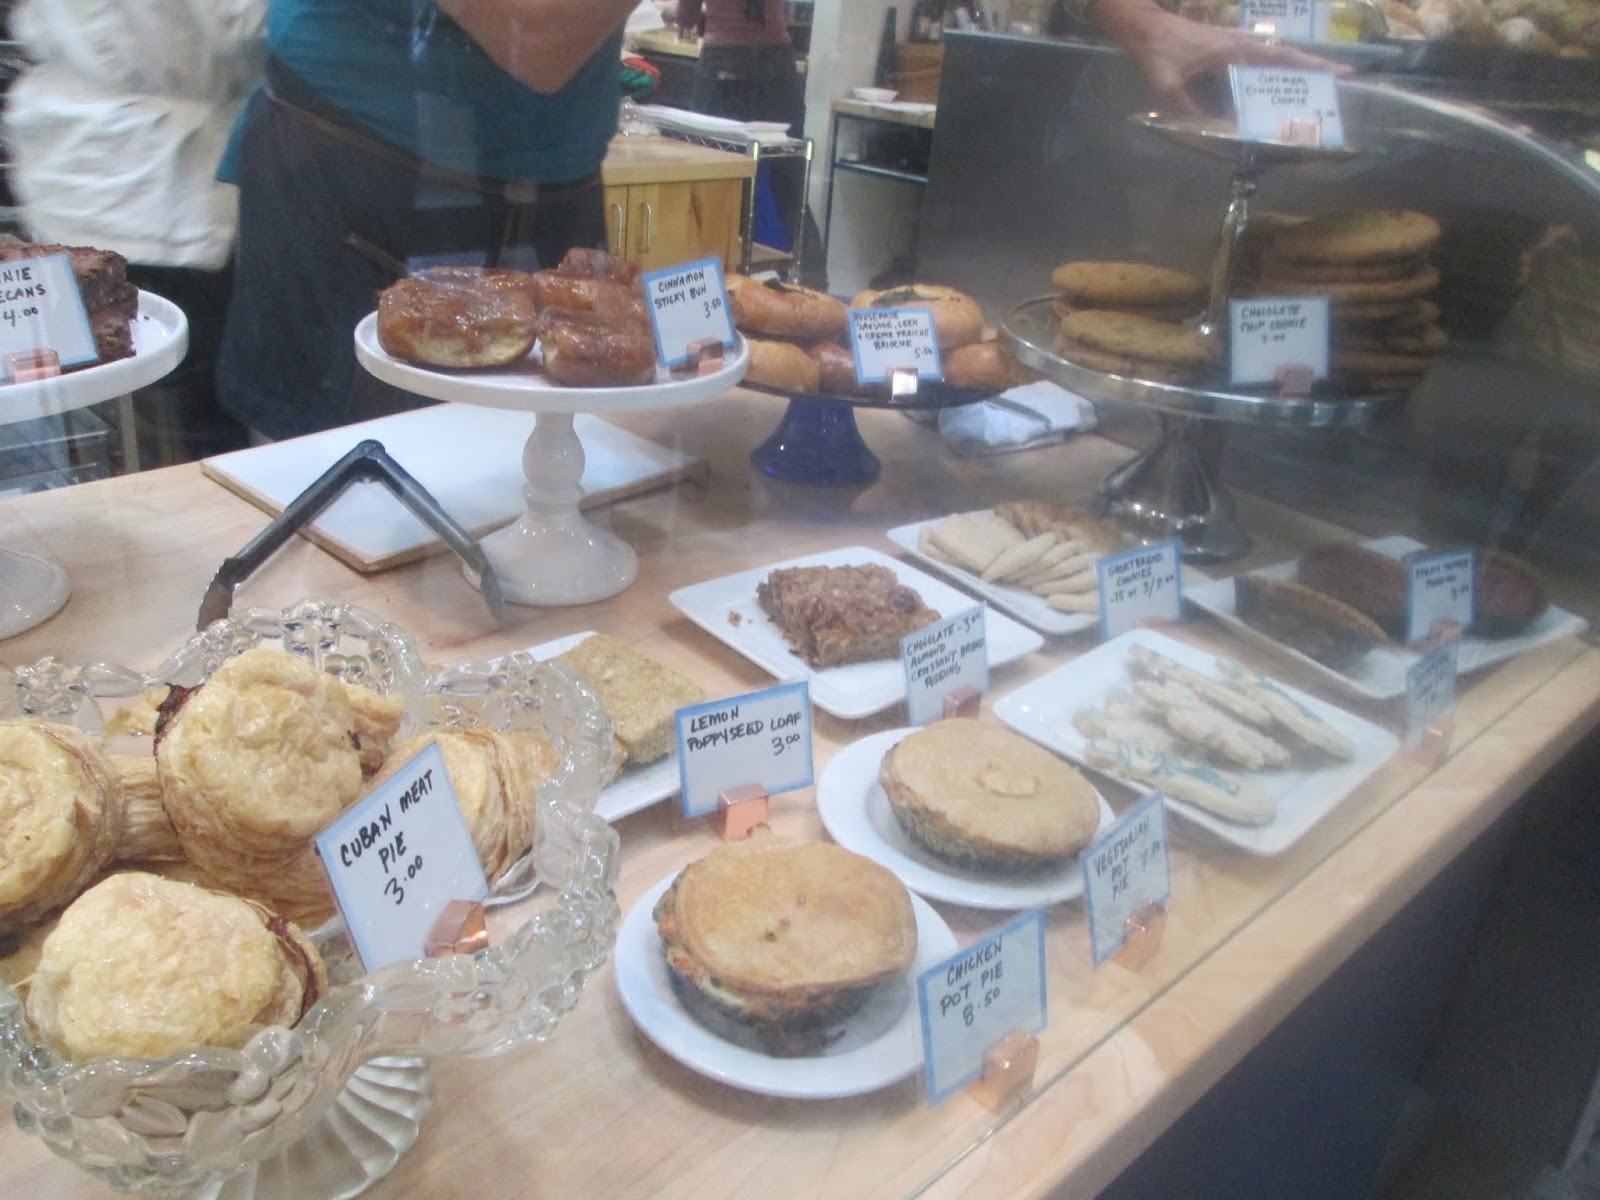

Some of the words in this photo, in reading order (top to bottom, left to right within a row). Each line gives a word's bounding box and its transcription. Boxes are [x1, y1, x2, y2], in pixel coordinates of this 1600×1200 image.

[658, 268, 704, 293] CINNAMON
[654, 290, 685, 309] STICKY
[690, 283, 706, 299] BUN
[703, 298, 721, 318] 3.50
[3, 307, 39, 327] 4.00
[873, 340, 912, 351] BRIOCHE
[907, 623, 954, 656] CHOCOLATE
[911, 643, 945, 669] ALMOND
[924, 662, 961, 689] PUDDING
[686, 720, 764, 752] POPPYSEED
[770, 712, 801, 731] LOAF
[690, 704, 739, 733] LEMON
[771, 733, 801, 756] 3.00
[340, 804, 392, 867] CUBAN
[399, 769, 432, 813] MEAT
[378, 831, 407, 874] PIE
[1094, 814, 1149, 877] VEGETARIAN
[384, 855, 423, 905] 3.00
[1112, 854, 1130, 883] POT
[1113, 872, 1129, 902] PIE
[947, 936, 1003, 987] CHICKEN
[940, 982, 971, 1016] POT
[981, 962, 1004, 988] PIE
[963, 987, 1000, 1026] 8.50
